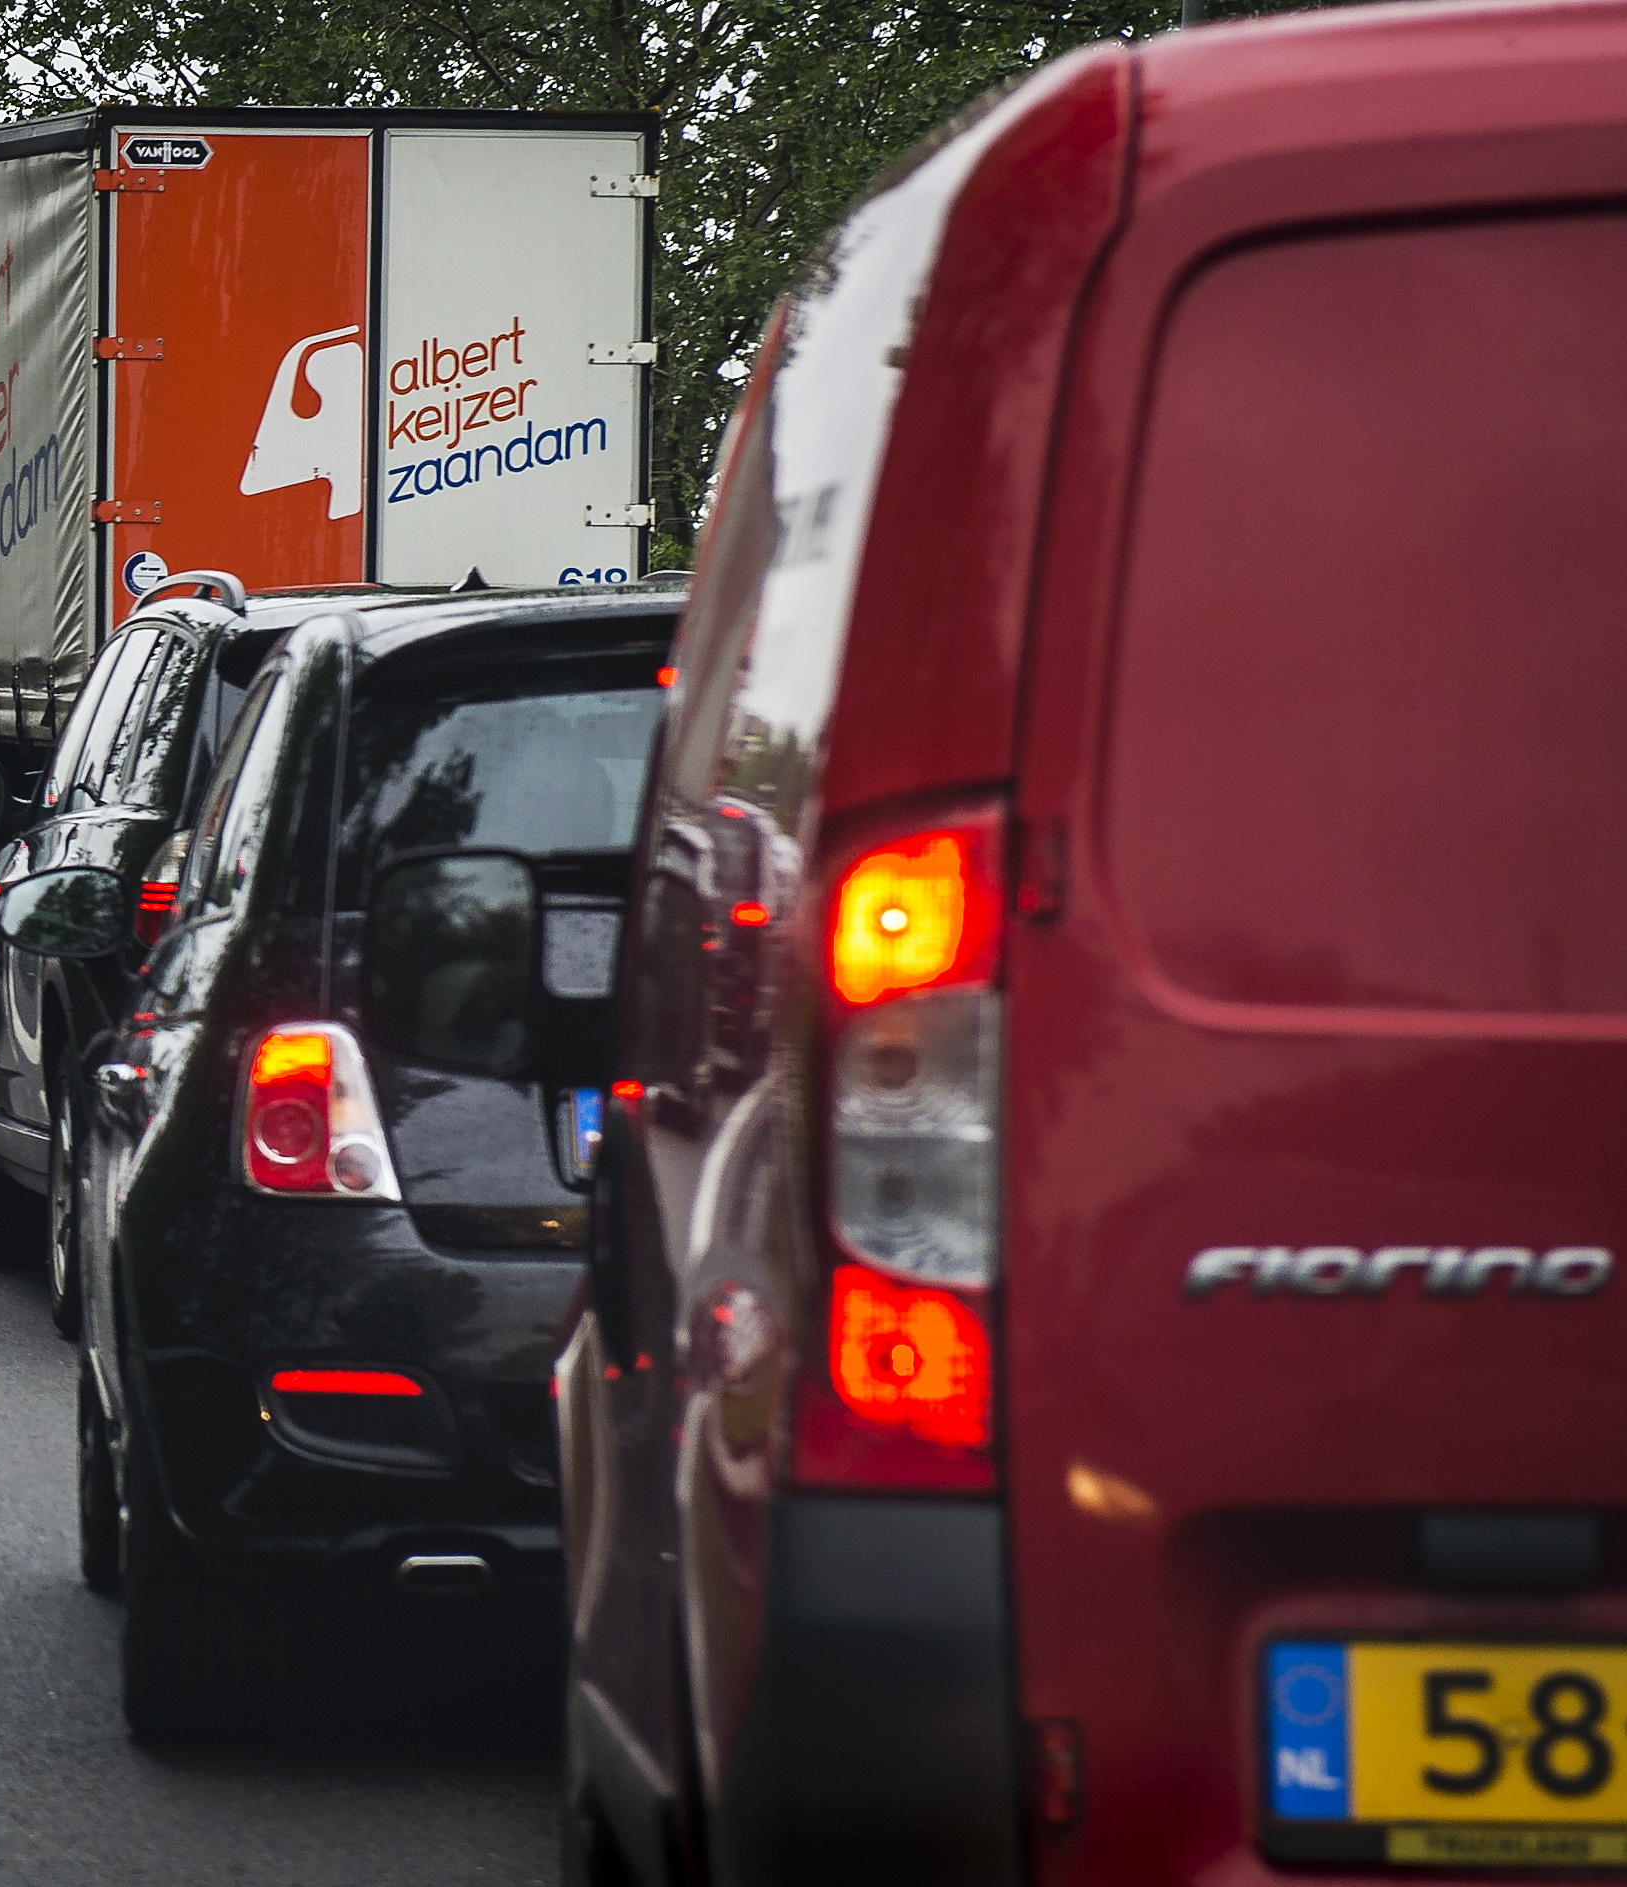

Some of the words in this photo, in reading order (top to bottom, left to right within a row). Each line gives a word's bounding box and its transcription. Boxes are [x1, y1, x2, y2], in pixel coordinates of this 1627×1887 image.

[389, 317, 526, 396] albert
[388, 378, 538, 451] keijzer
[387, 417, 607, 504] zaandam
[1276, 1746, 1342, 1791] NL
